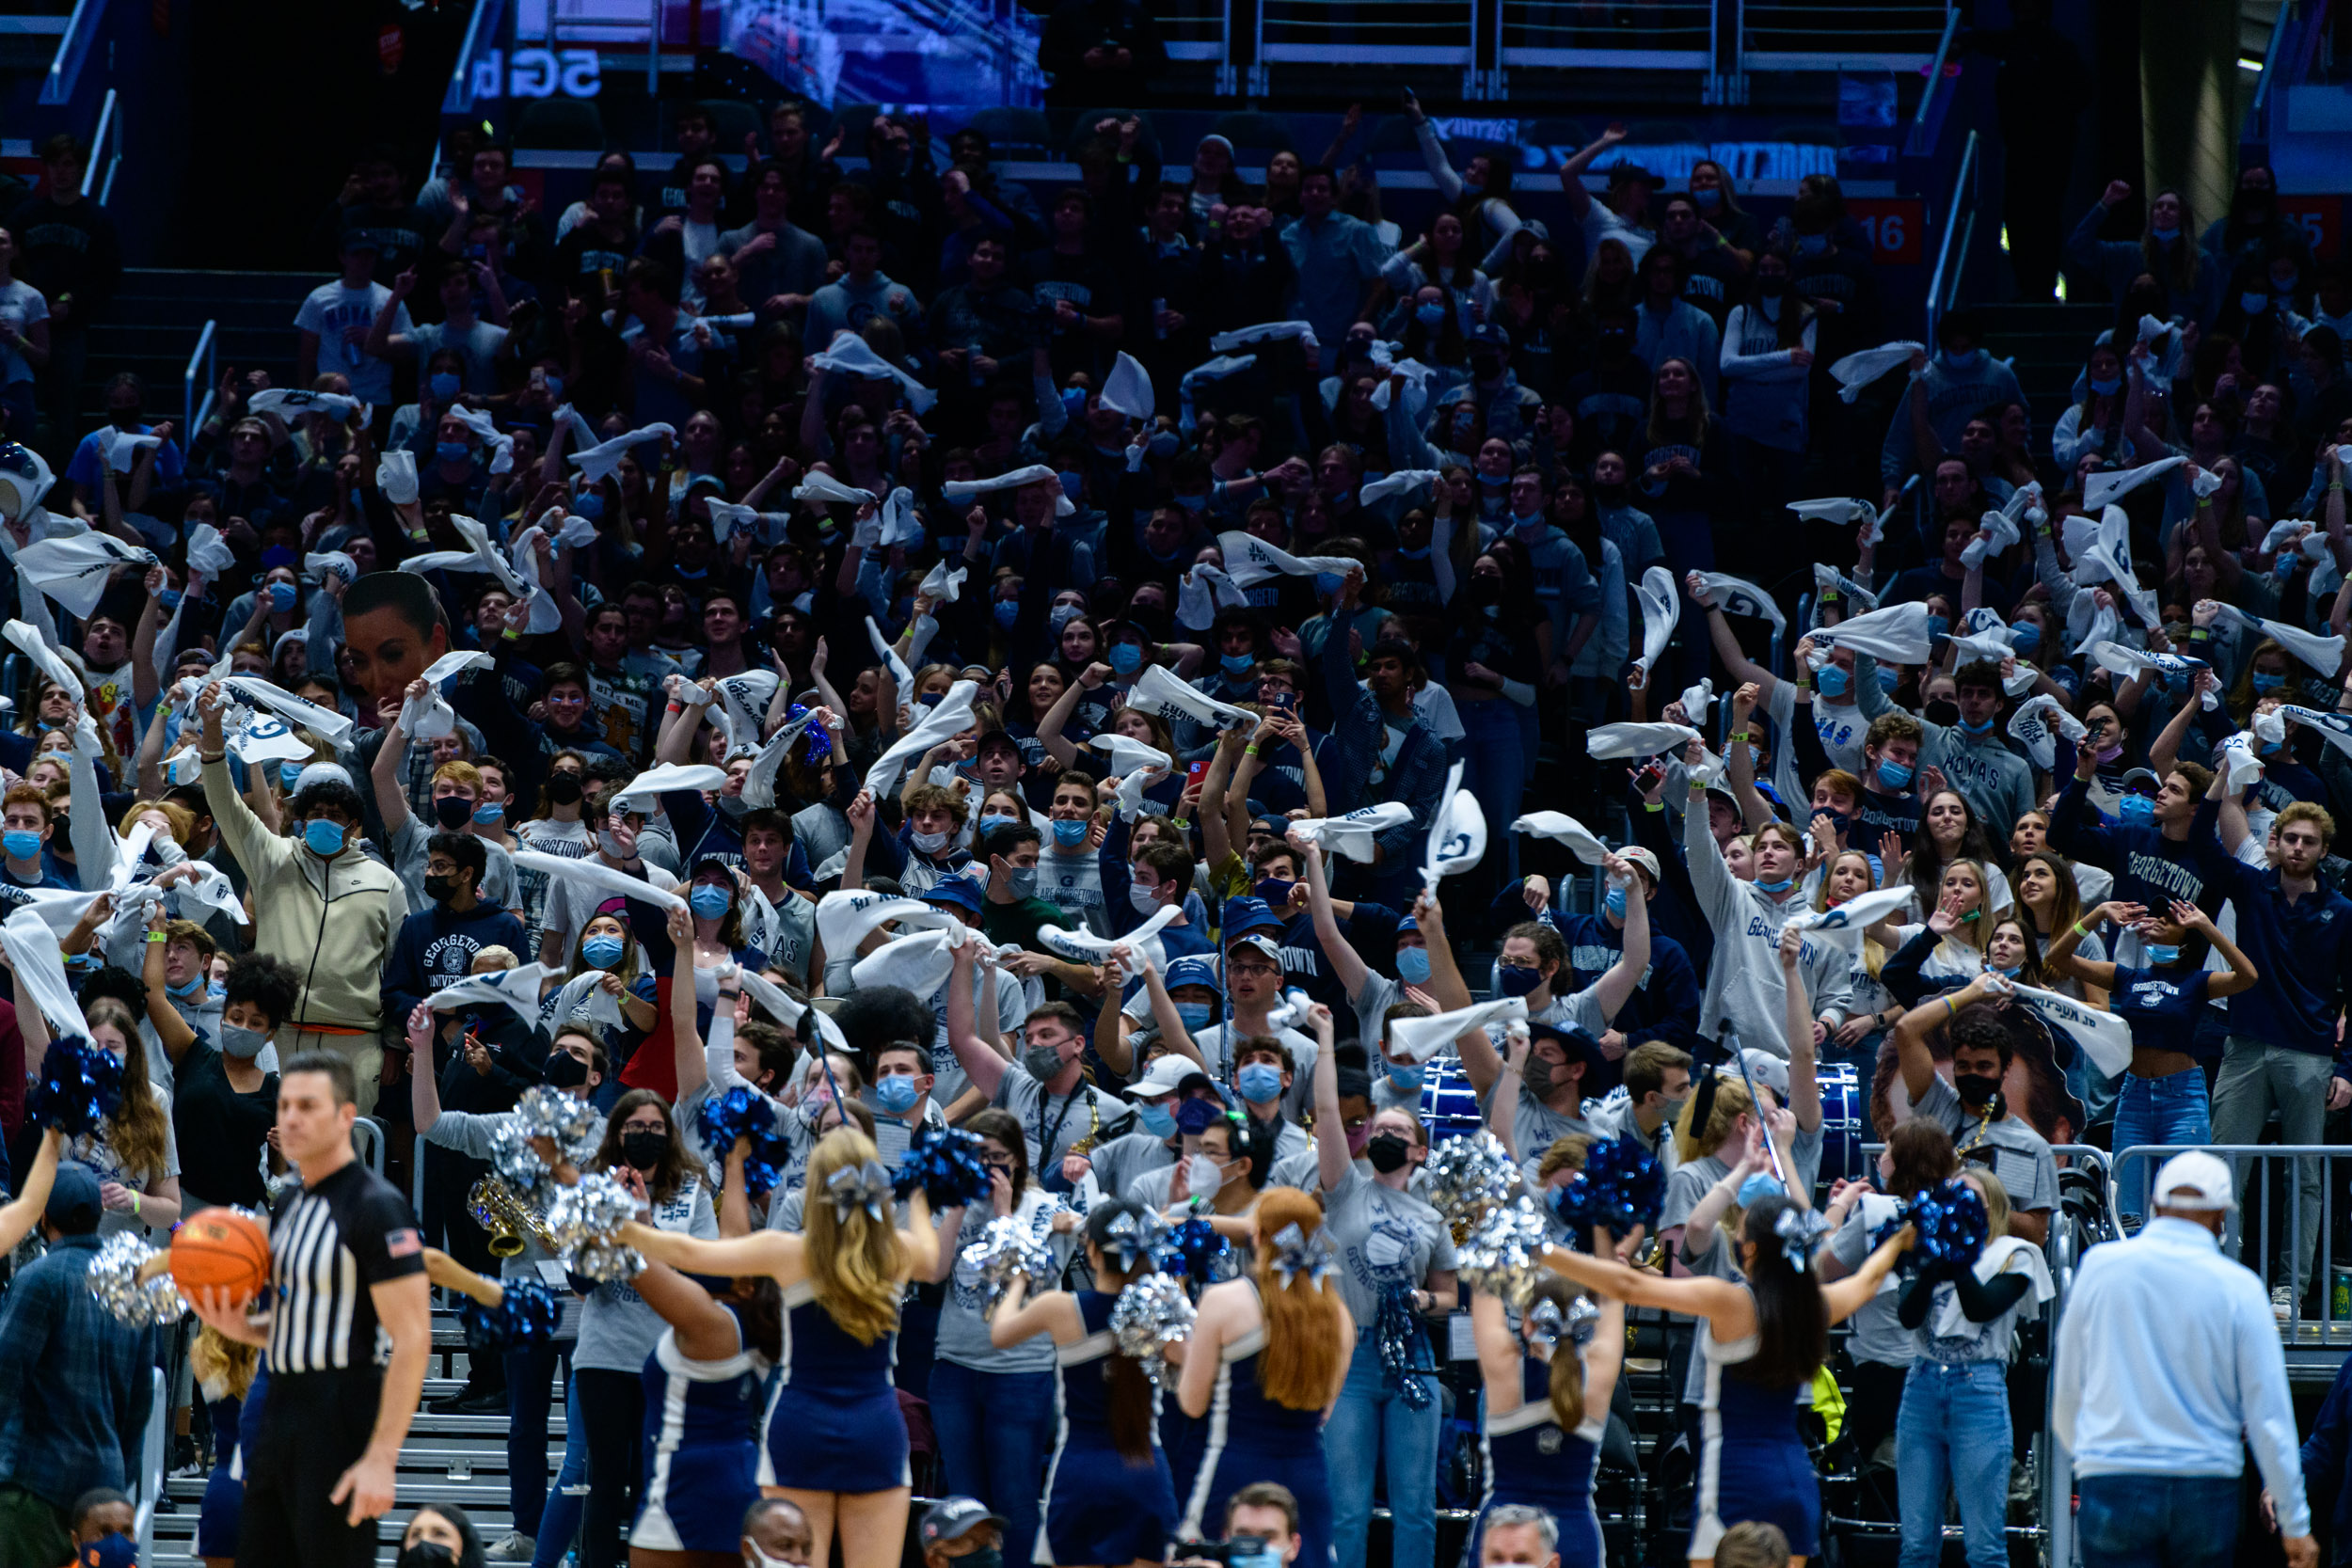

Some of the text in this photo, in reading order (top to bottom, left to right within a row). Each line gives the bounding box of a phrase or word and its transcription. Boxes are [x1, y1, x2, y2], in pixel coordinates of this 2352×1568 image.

[1860, 215, 1905, 251] 16
[1060, 876, 1074, 887] G
[2128, 850, 2204, 905] GEORGETOWN
[2132, 980, 2180, 996] GEORGETOWN
[1533, 1129, 1553, 1142] WE
